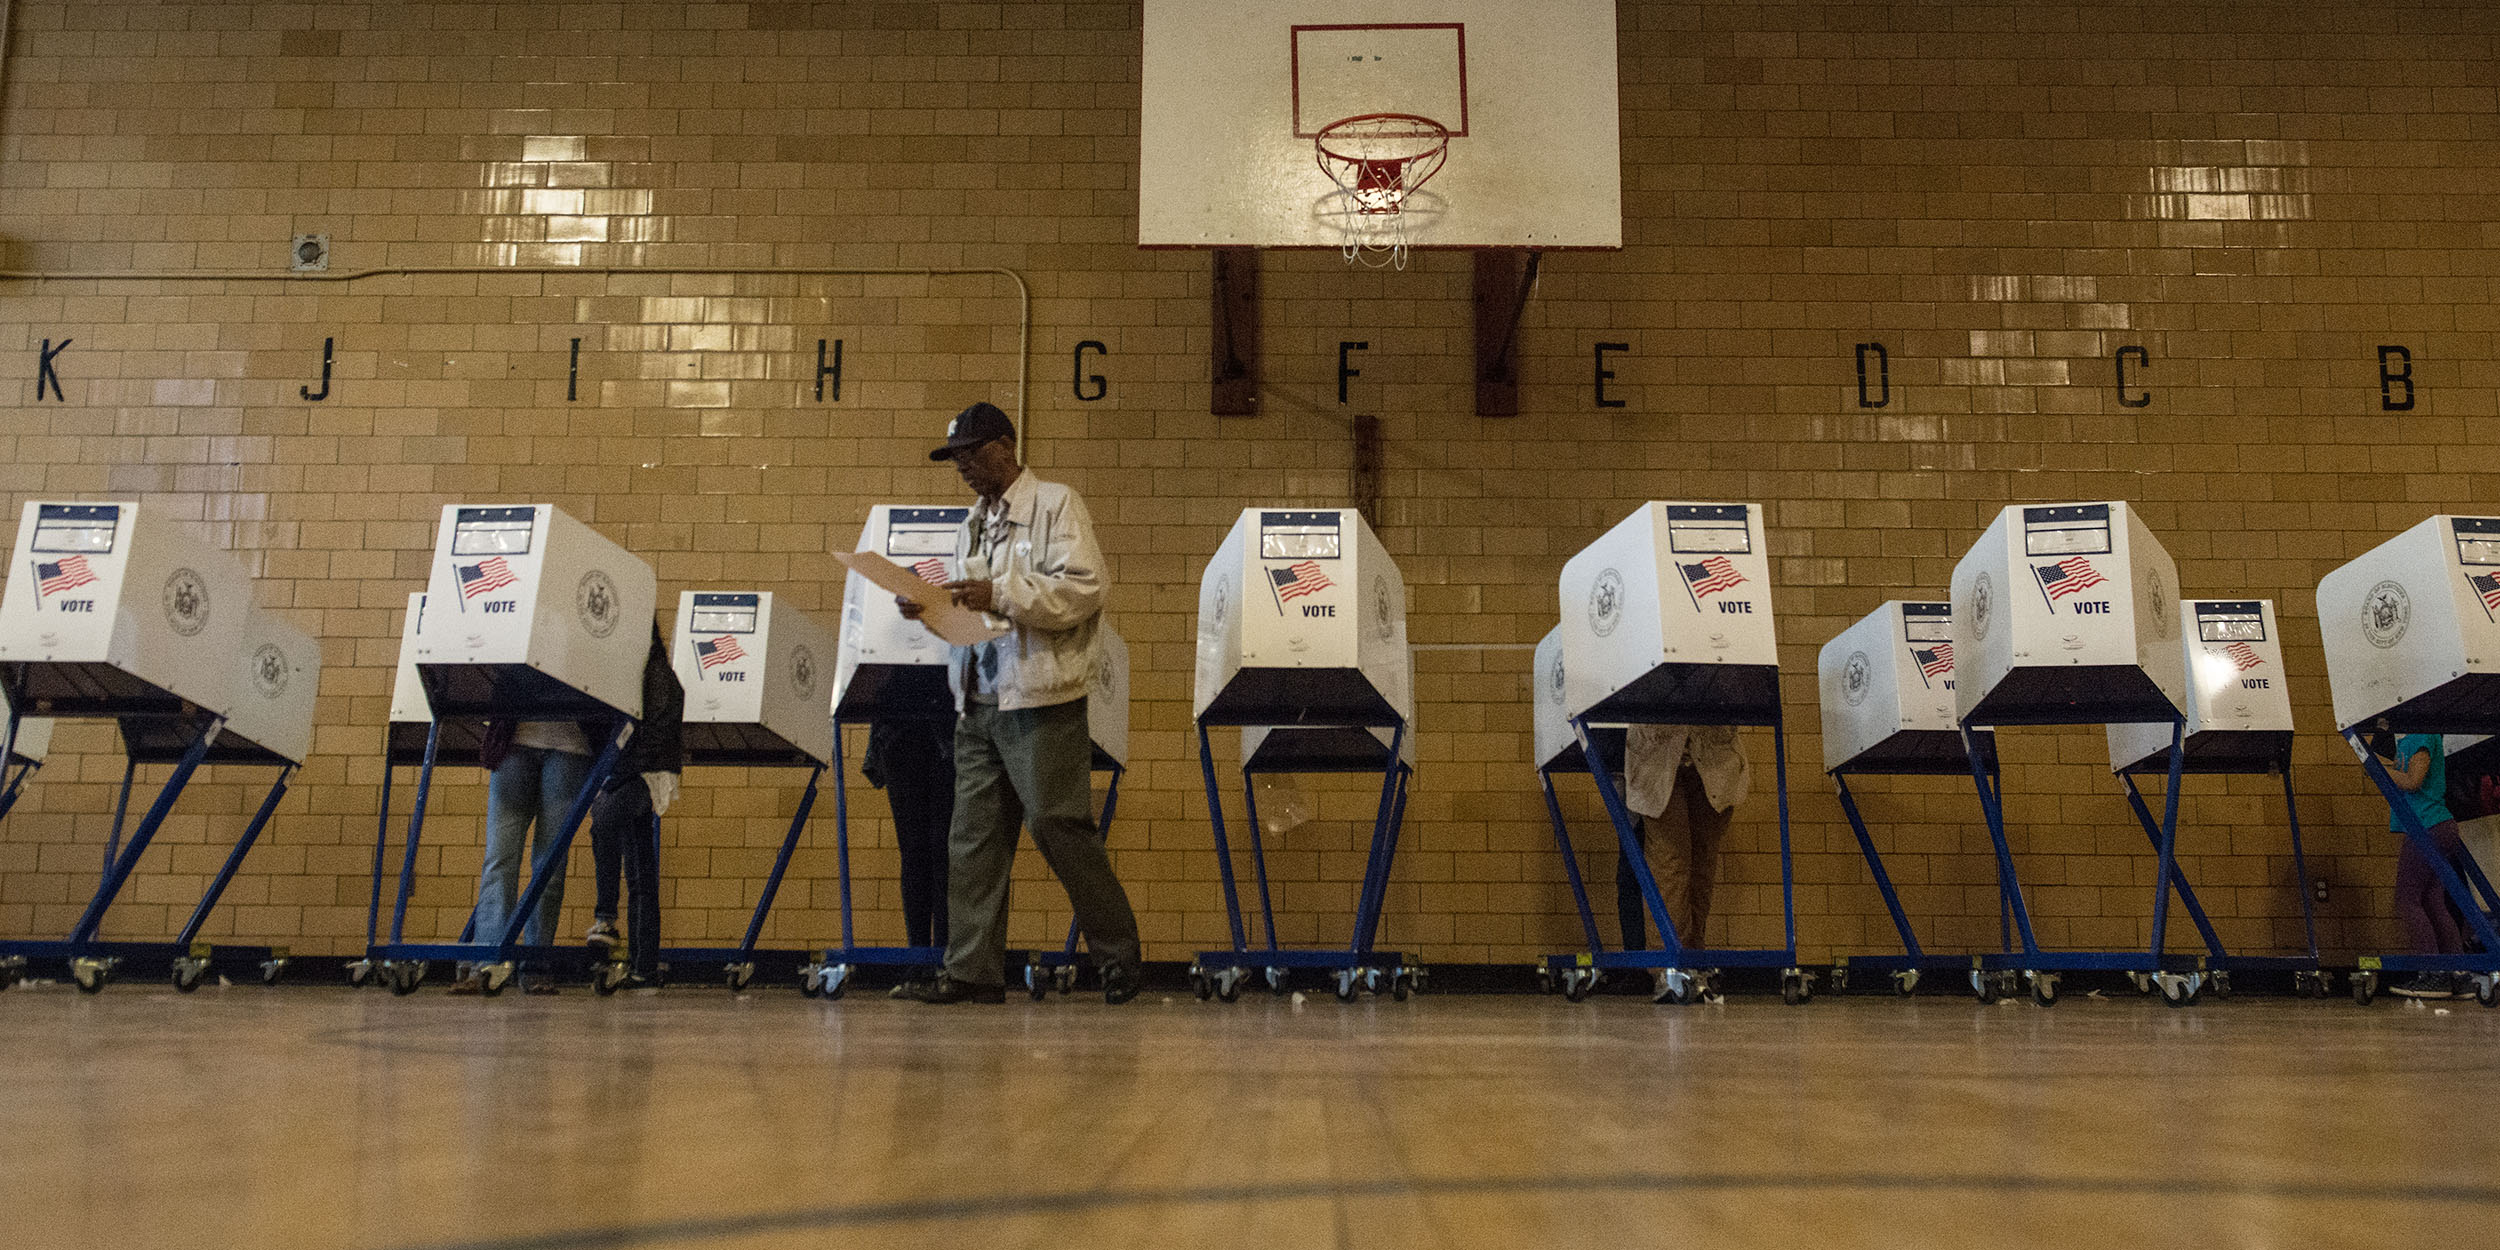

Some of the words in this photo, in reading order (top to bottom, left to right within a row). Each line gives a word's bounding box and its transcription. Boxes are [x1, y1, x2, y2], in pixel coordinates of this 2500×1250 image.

[38, 339, 71, 401] K
[301, 338, 334, 401] J
[567, 338, 581, 401] I
[816, 339, 843, 402] H
[1074, 341, 1107, 402] G
[1338, 341, 1369, 404] F
[1595, 343, 1630, 408] E
[1856, 343, 1889, 408] D
[2115, 345, 2150, 408] C
[2378, 345, 2415, 411] B
[61, 600, 94, 613] VOTE
[484, 601, 516, 613] VOTE
[1302, 605, 1336, 618] VOTE
[1718, 601, 1752, 614] VOTE
[2074, 601, 2111, 614] VOTE
[718, 671, 745, 682] VOTE
[2241, 678, 2270, 690] VOTE
